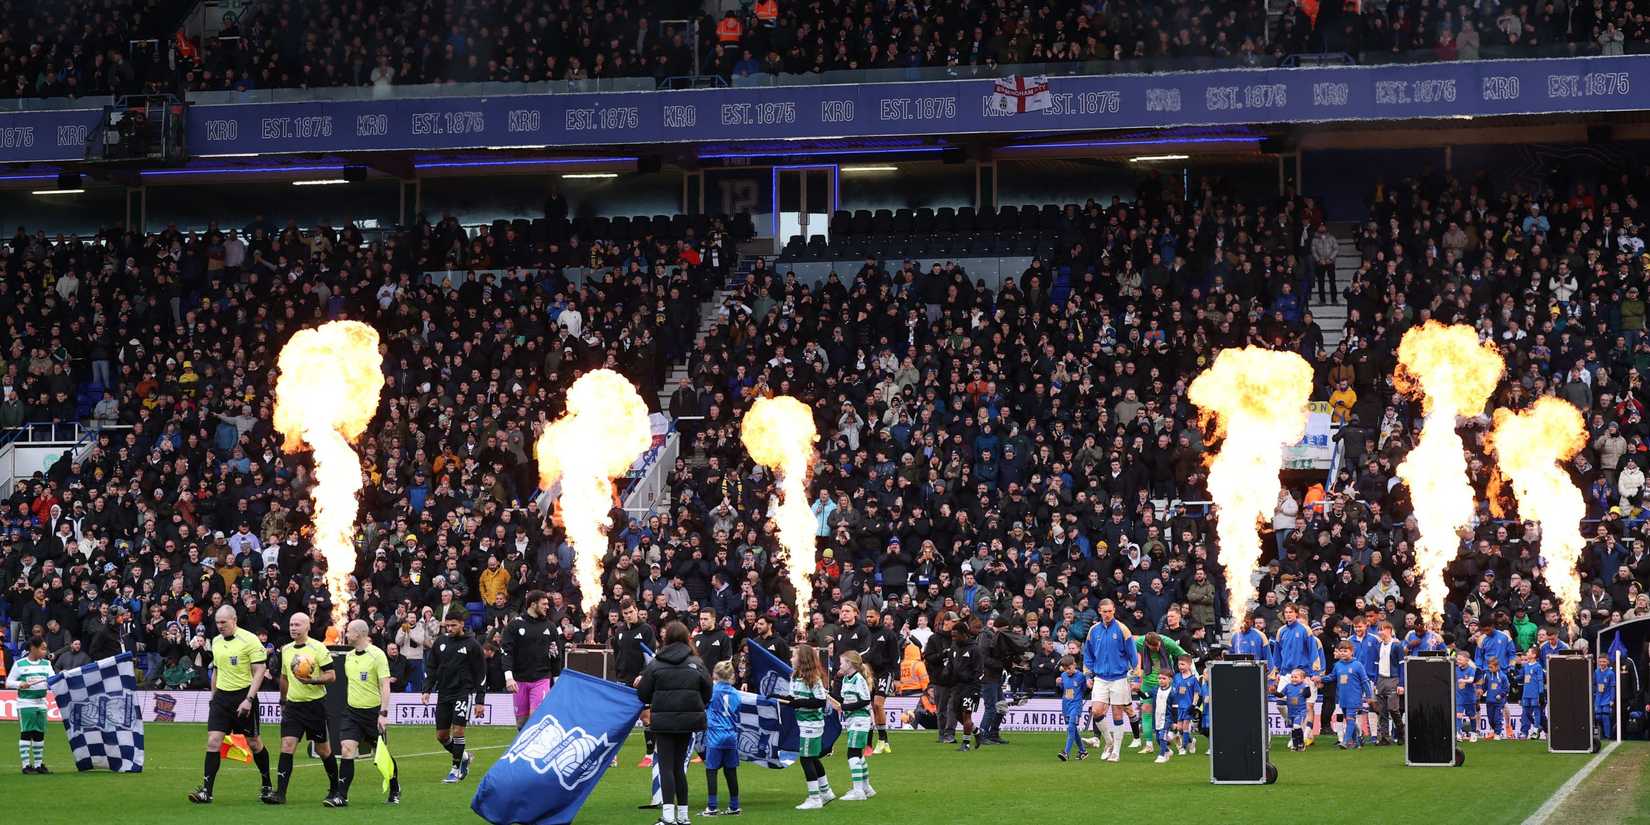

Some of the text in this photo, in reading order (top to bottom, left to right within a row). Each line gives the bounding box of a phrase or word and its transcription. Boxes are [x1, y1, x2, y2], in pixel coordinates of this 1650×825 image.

[207, 119, 238, 141] KRO
[356, 114, 388, 136] KRO
[508, 110, 540, 132] KRO
[664, 104, 697, 127] KRO
[821, 100, 855, 122] KRO
[1483, 76, 1520, 100] KRO
[57, 125, 88, 146] KRO
[454, 700, 467, 711] 24
